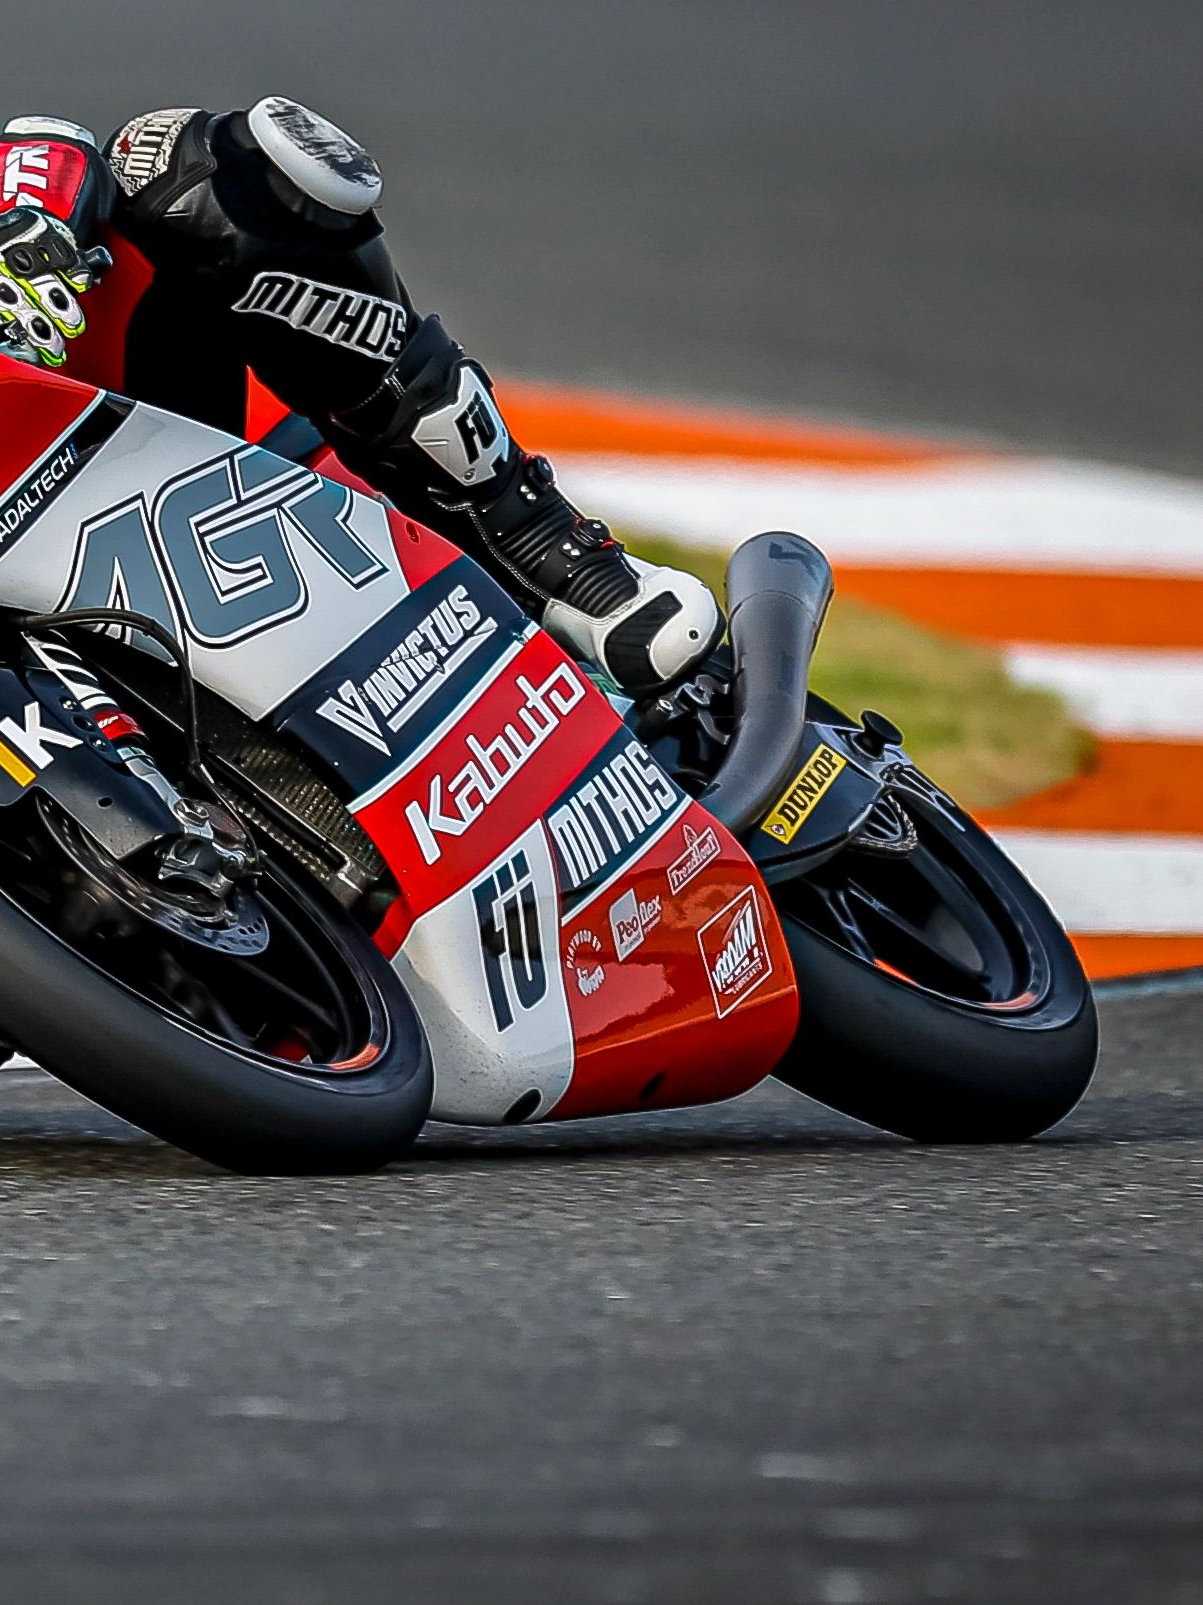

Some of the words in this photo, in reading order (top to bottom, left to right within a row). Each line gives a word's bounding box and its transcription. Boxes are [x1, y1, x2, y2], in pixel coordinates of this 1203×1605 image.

[233, 272, 408, 362] MITHOS
[404, 661, 587, 866] Kabuto
[547, 740, 680, 888] MITHOS
[776, 748, 838, 828] DUNLOP
